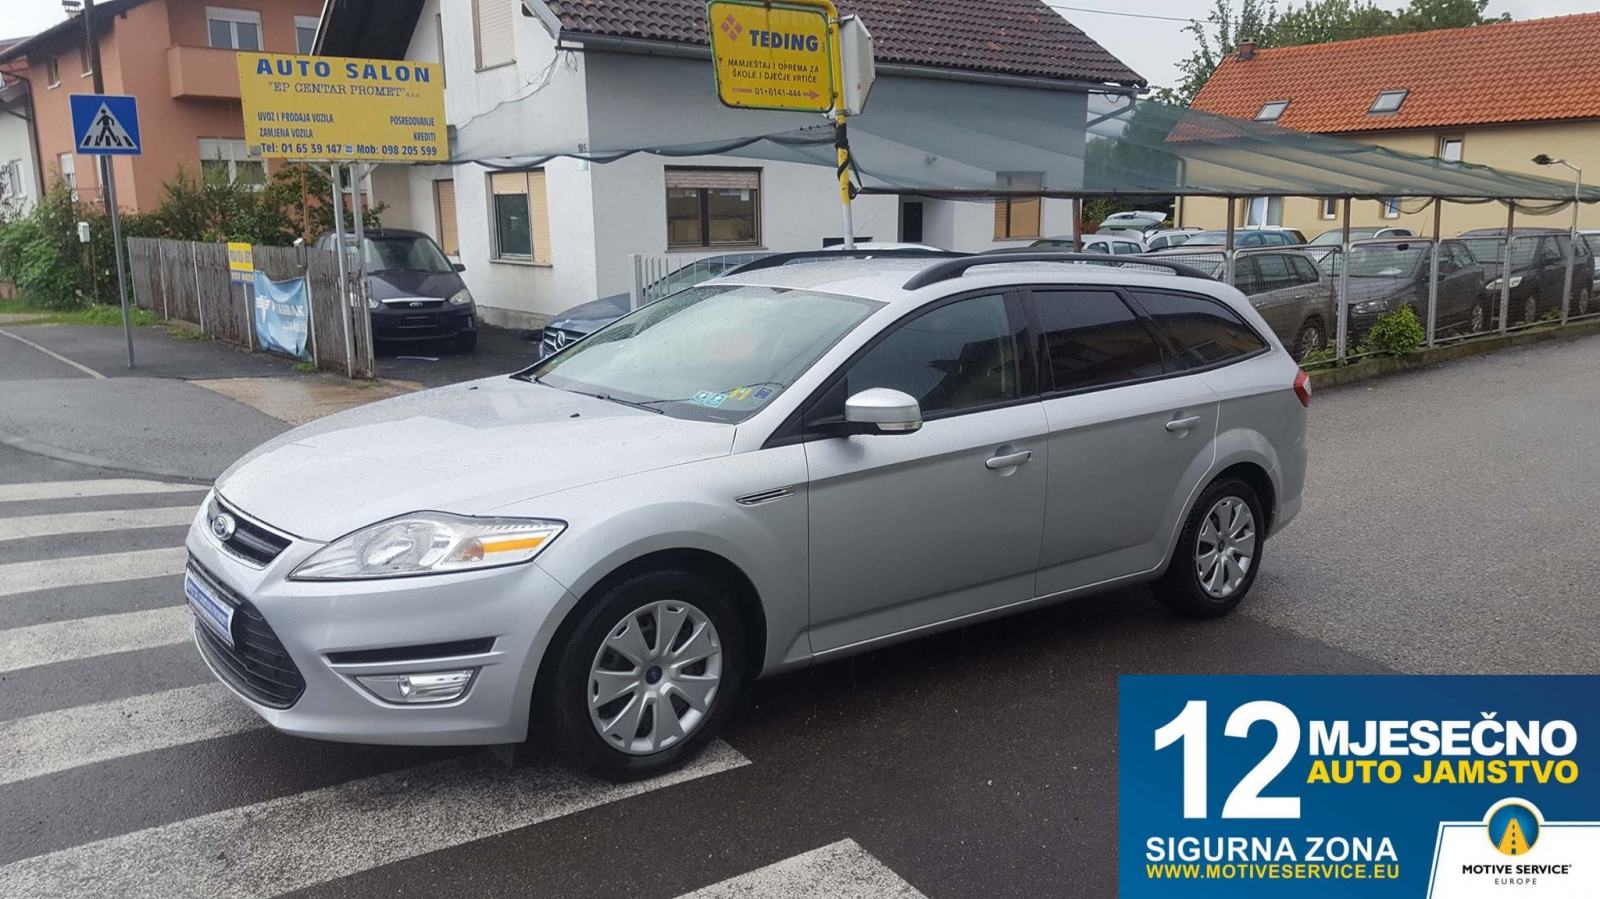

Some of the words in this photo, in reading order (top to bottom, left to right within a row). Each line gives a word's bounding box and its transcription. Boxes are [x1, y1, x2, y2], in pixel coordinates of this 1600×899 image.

[749, 29, 818, 52] TEDING
[256, 58, 331, 78] AUTO
[345, 63, 430, 83] SALON
[728, 58, 771, 70] NAMJEŠTAJ
[778, 62, 807, 73] OPREMA
[810, 65, 819, 73] ZA
[732, 69, 757, 79] ŠKOLE
[294, 82, 347, 95] CENTAR
[257, 111, 276, 122] UVOZ
[281, 112, 311, 123] PRODAJA
[311, 112, 334, 124] VOZILA
[389, 115, 435, 127] POSREDOVANJE
[259, 127, 290, 138] ZAMJENA
[290, 128, 314, 139] VOZILA
[413, 132, 436, 142] KREDITI
[260, 142, 279, 154] Tel:
[281, 143, 293, 153] 01
[295, 143, 308, 154] 65
[311, 143, 323, 154] 39
[326, 144, 342, 154] 147
[356, 144, 379, 155] Mob:
[381, 145, 399, 155] 098
[402, 145, 418, 156] 205
[420, 146, 437, 156] 599
